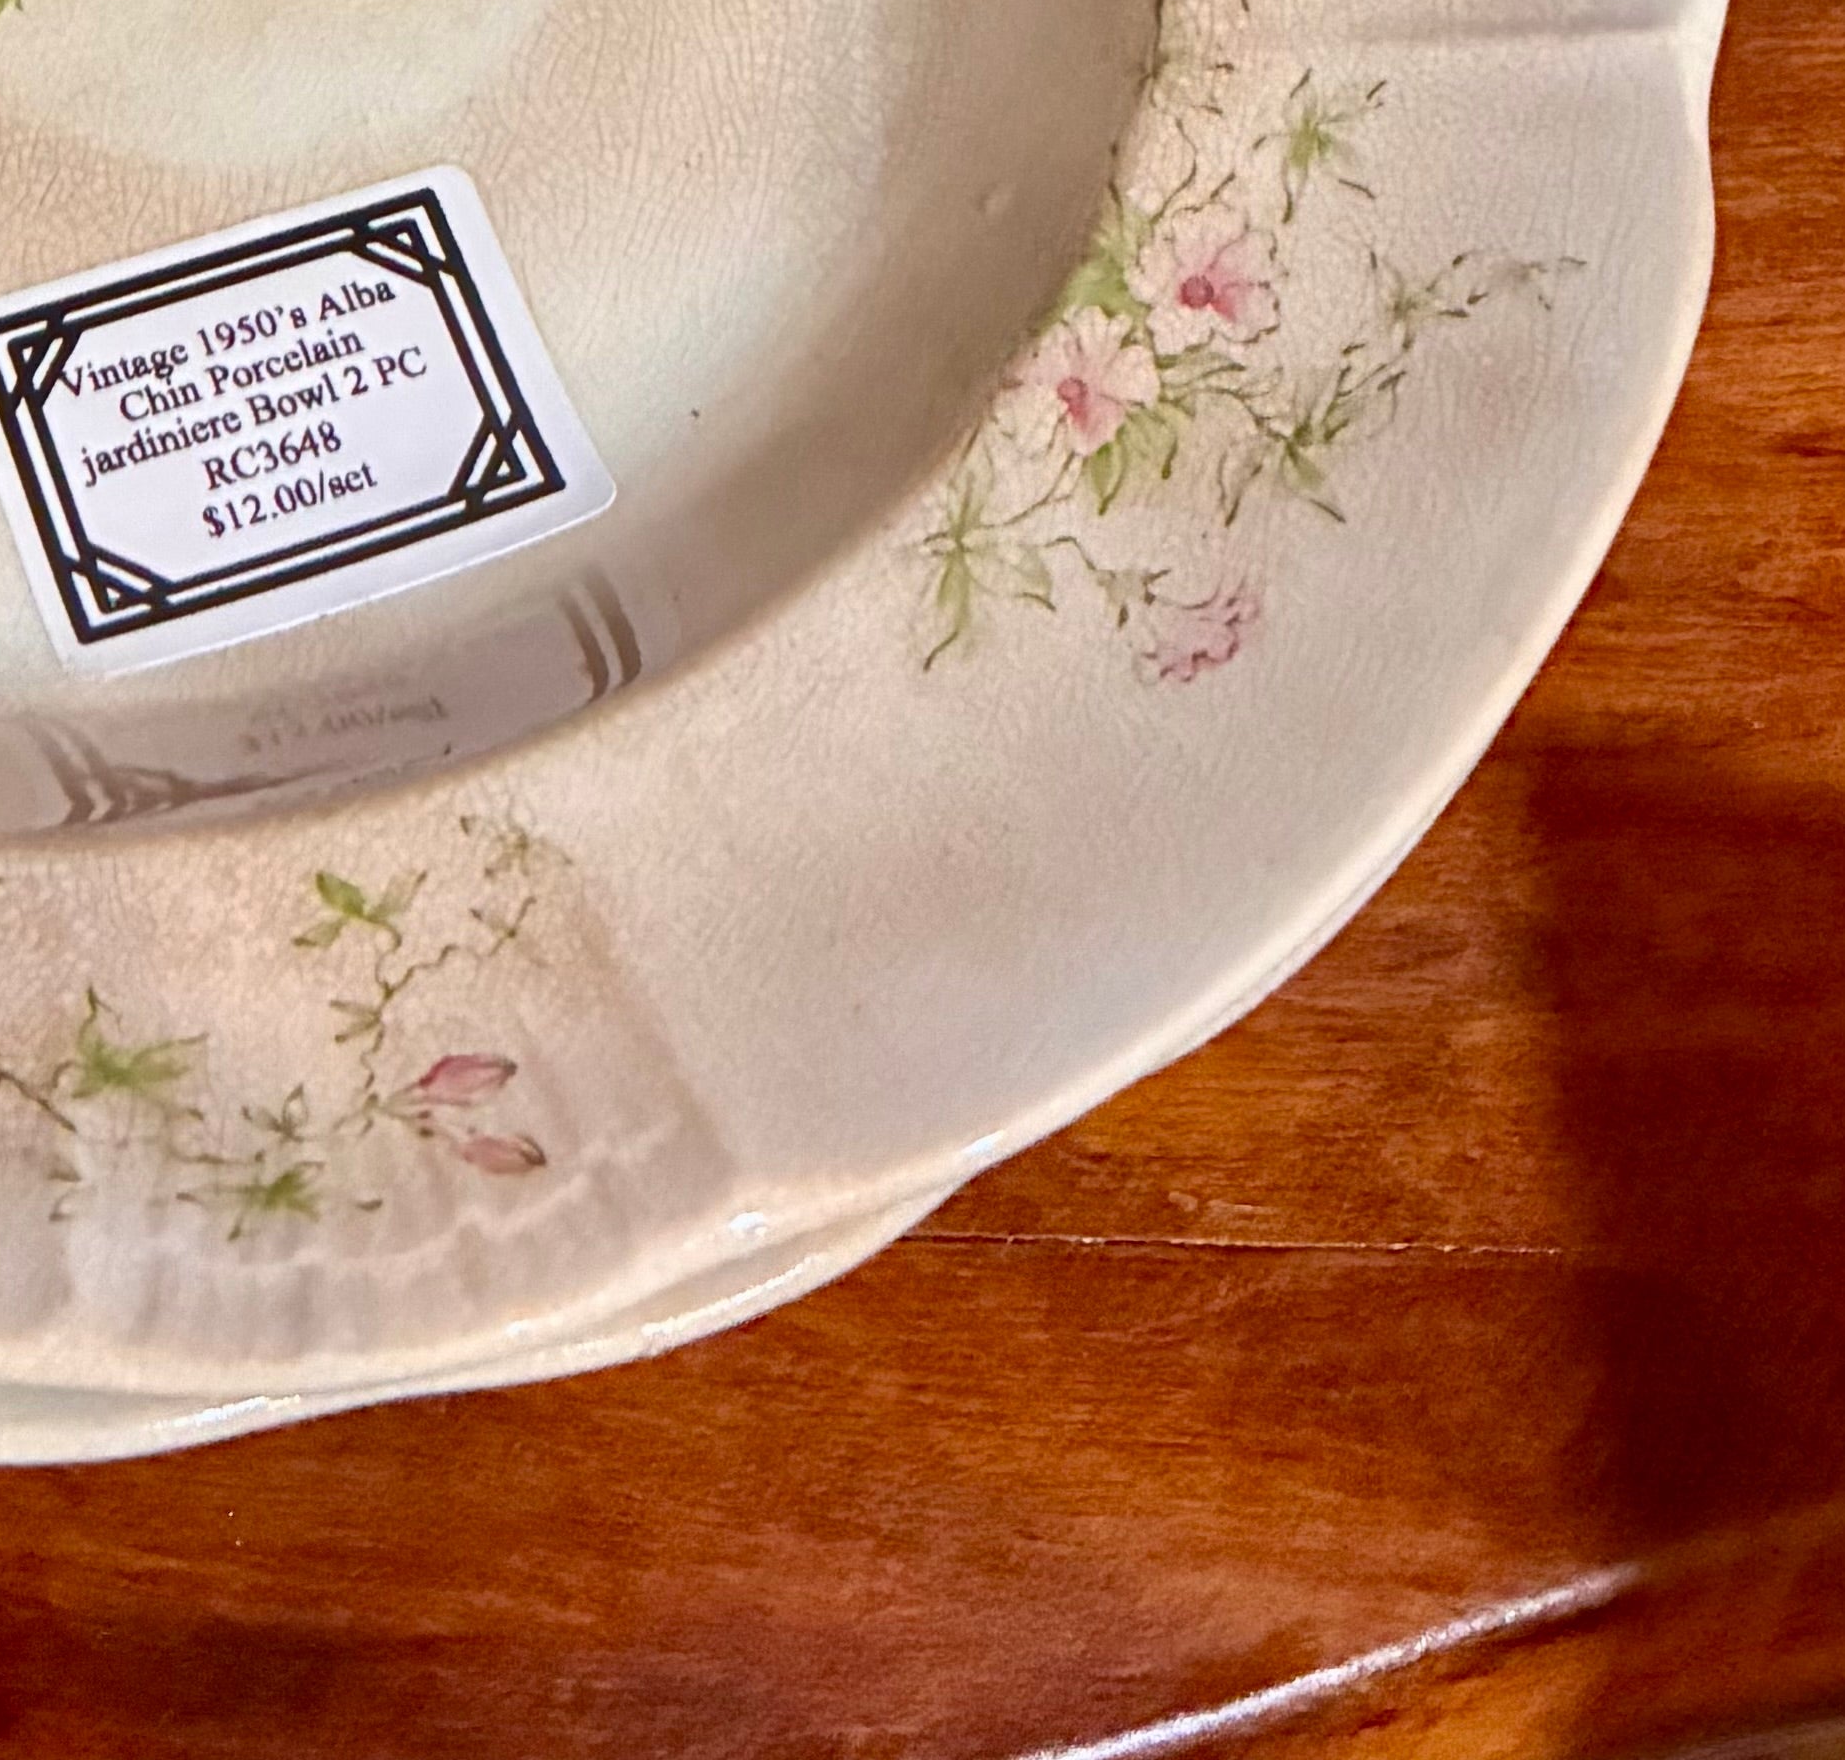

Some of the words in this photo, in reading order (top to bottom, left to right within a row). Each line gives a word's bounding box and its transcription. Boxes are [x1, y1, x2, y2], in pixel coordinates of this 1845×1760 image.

[61, 344, 189, 398] Vintage
[319, 279, 396, 321] Alba
[120, 379, 202, 423] Chin
[210, 329, 365, 395] Porcelain
[81, 407, 242, 487] jardiniere
[249, 372, 341, 426] Bowl
[343, 367, 369, 397] 2
[372, 346, 428, 387] PC
[202, 421, 342, 491] RC3648
[202, 460, 378, 539] $12.00/set
